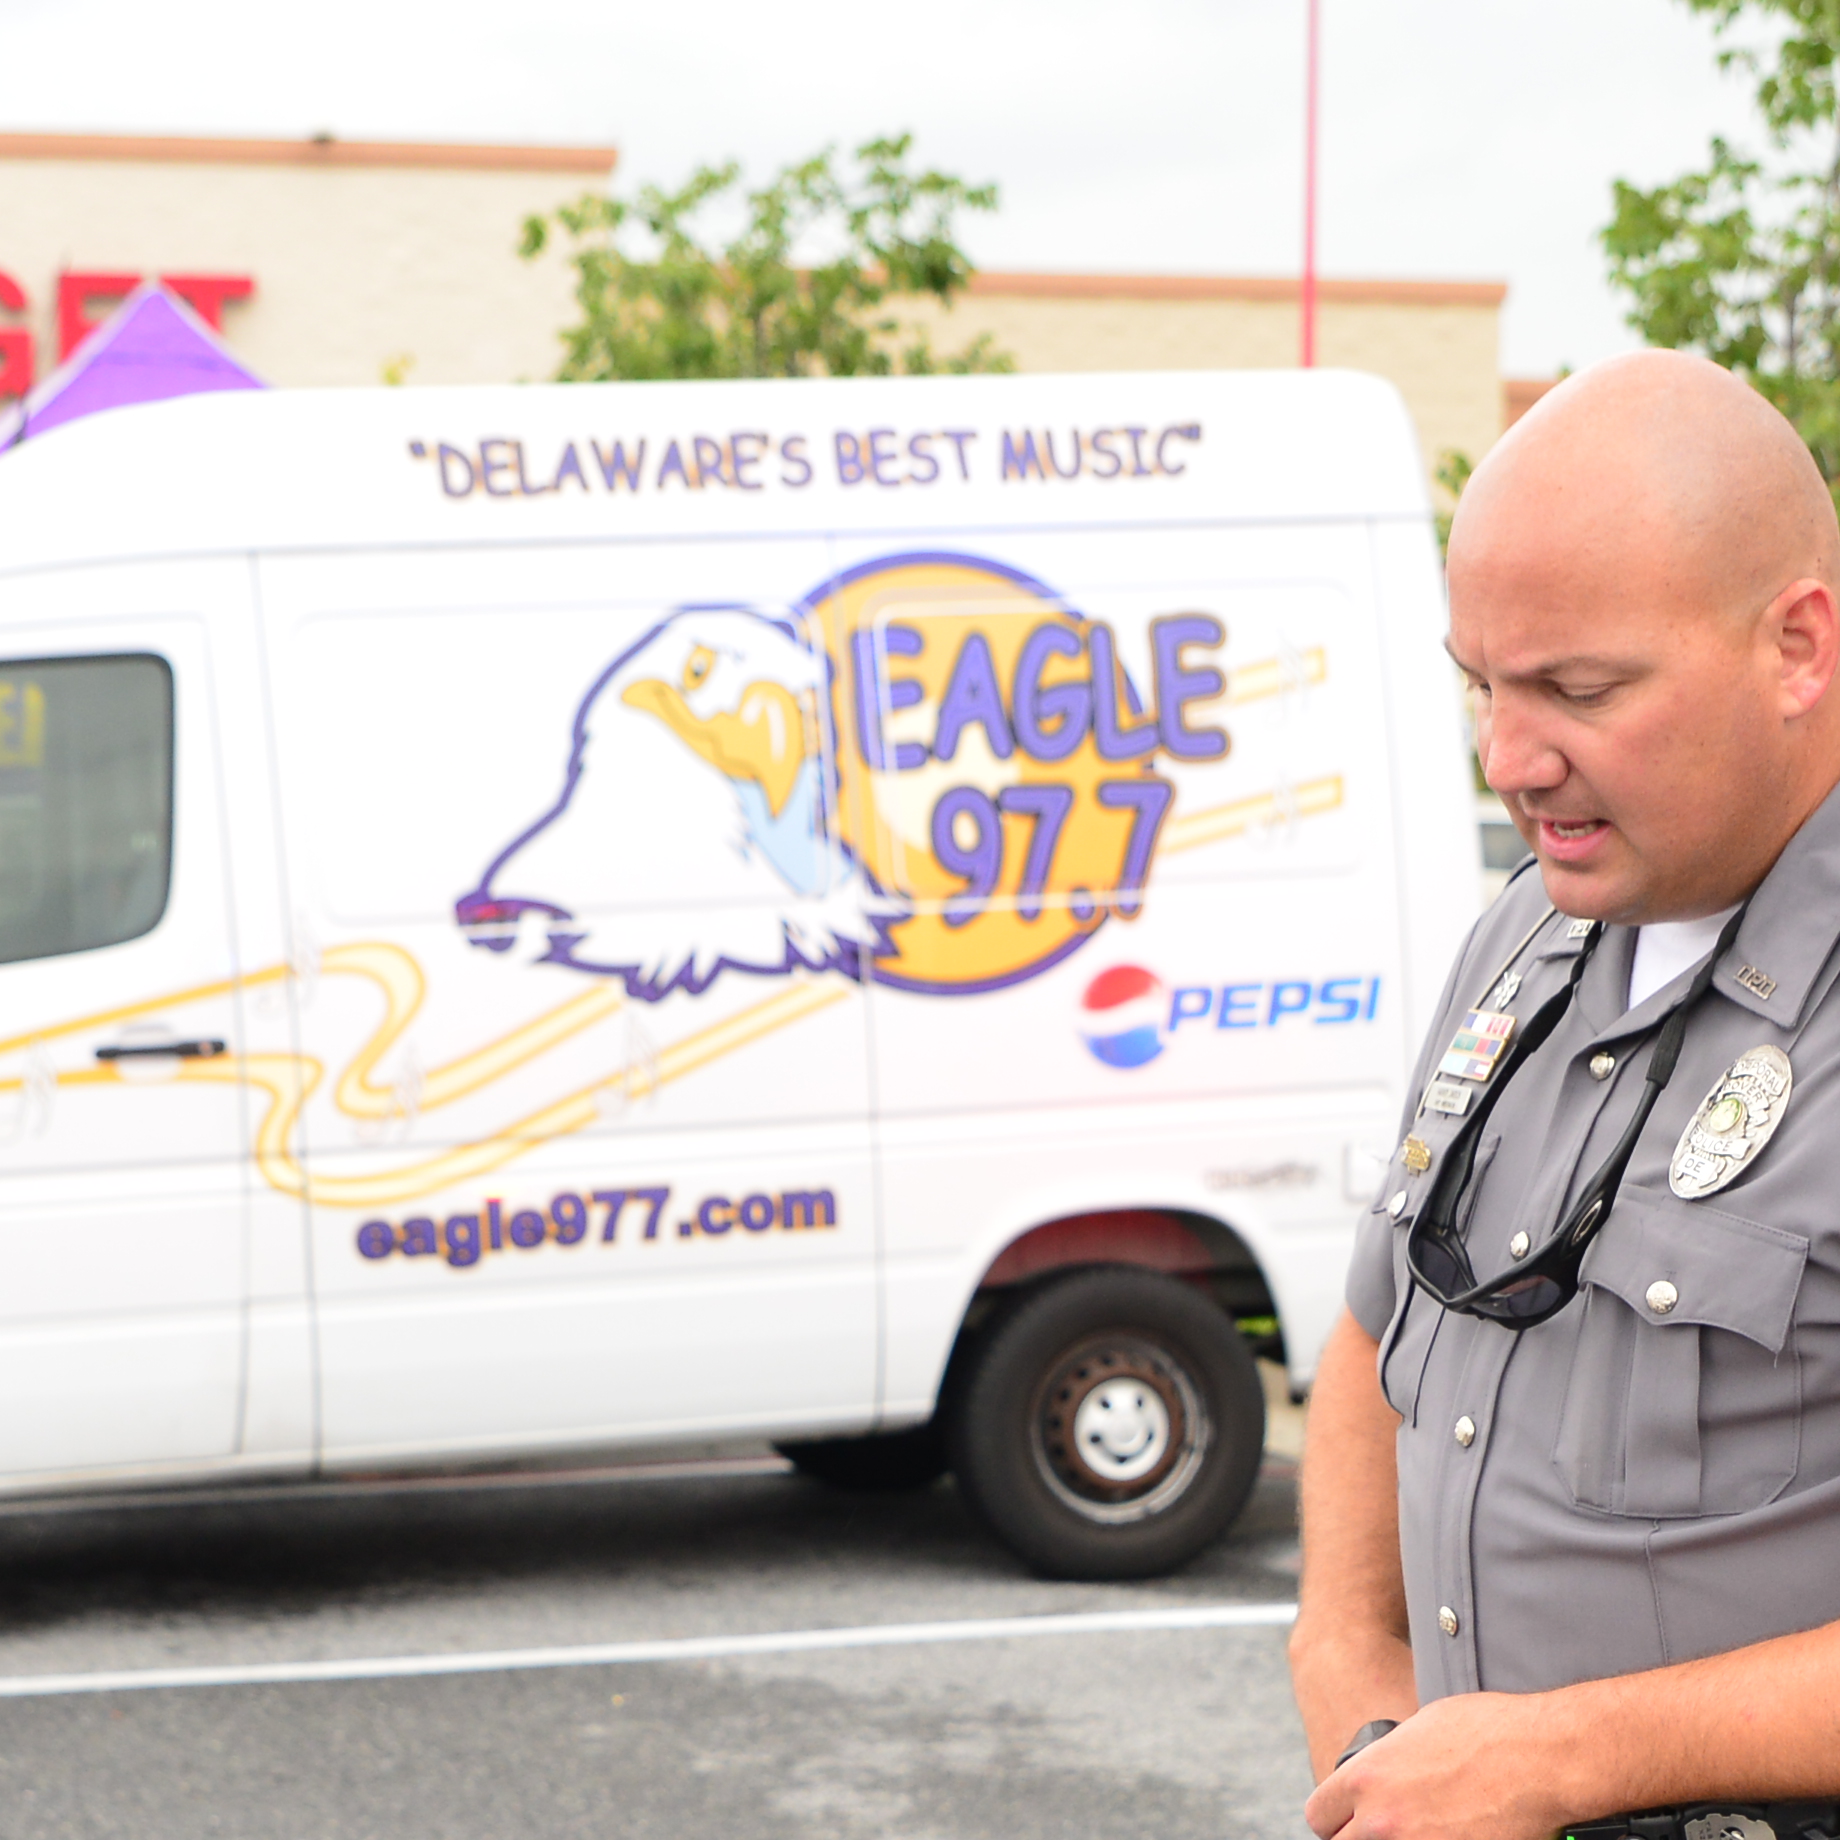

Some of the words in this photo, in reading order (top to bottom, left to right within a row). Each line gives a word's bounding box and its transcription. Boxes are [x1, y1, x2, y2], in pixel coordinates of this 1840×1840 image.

[832, 429, 978, 488] BEST
[1000, 422, 1202, 483] MUSIC"
[848, 611, 1231, 771] EAGLE
[928, 778, 1177, 930] 97.7
[1164, 976, 1383, 1033] PEPSI
[1723, 1080, 1764, 1103] DOVER
[1684, 1157, 1706, 1173] DE
[1691, 1127, 1733, 1153] POLICE
[357, 1182, 837, 1267] eagle977.com
